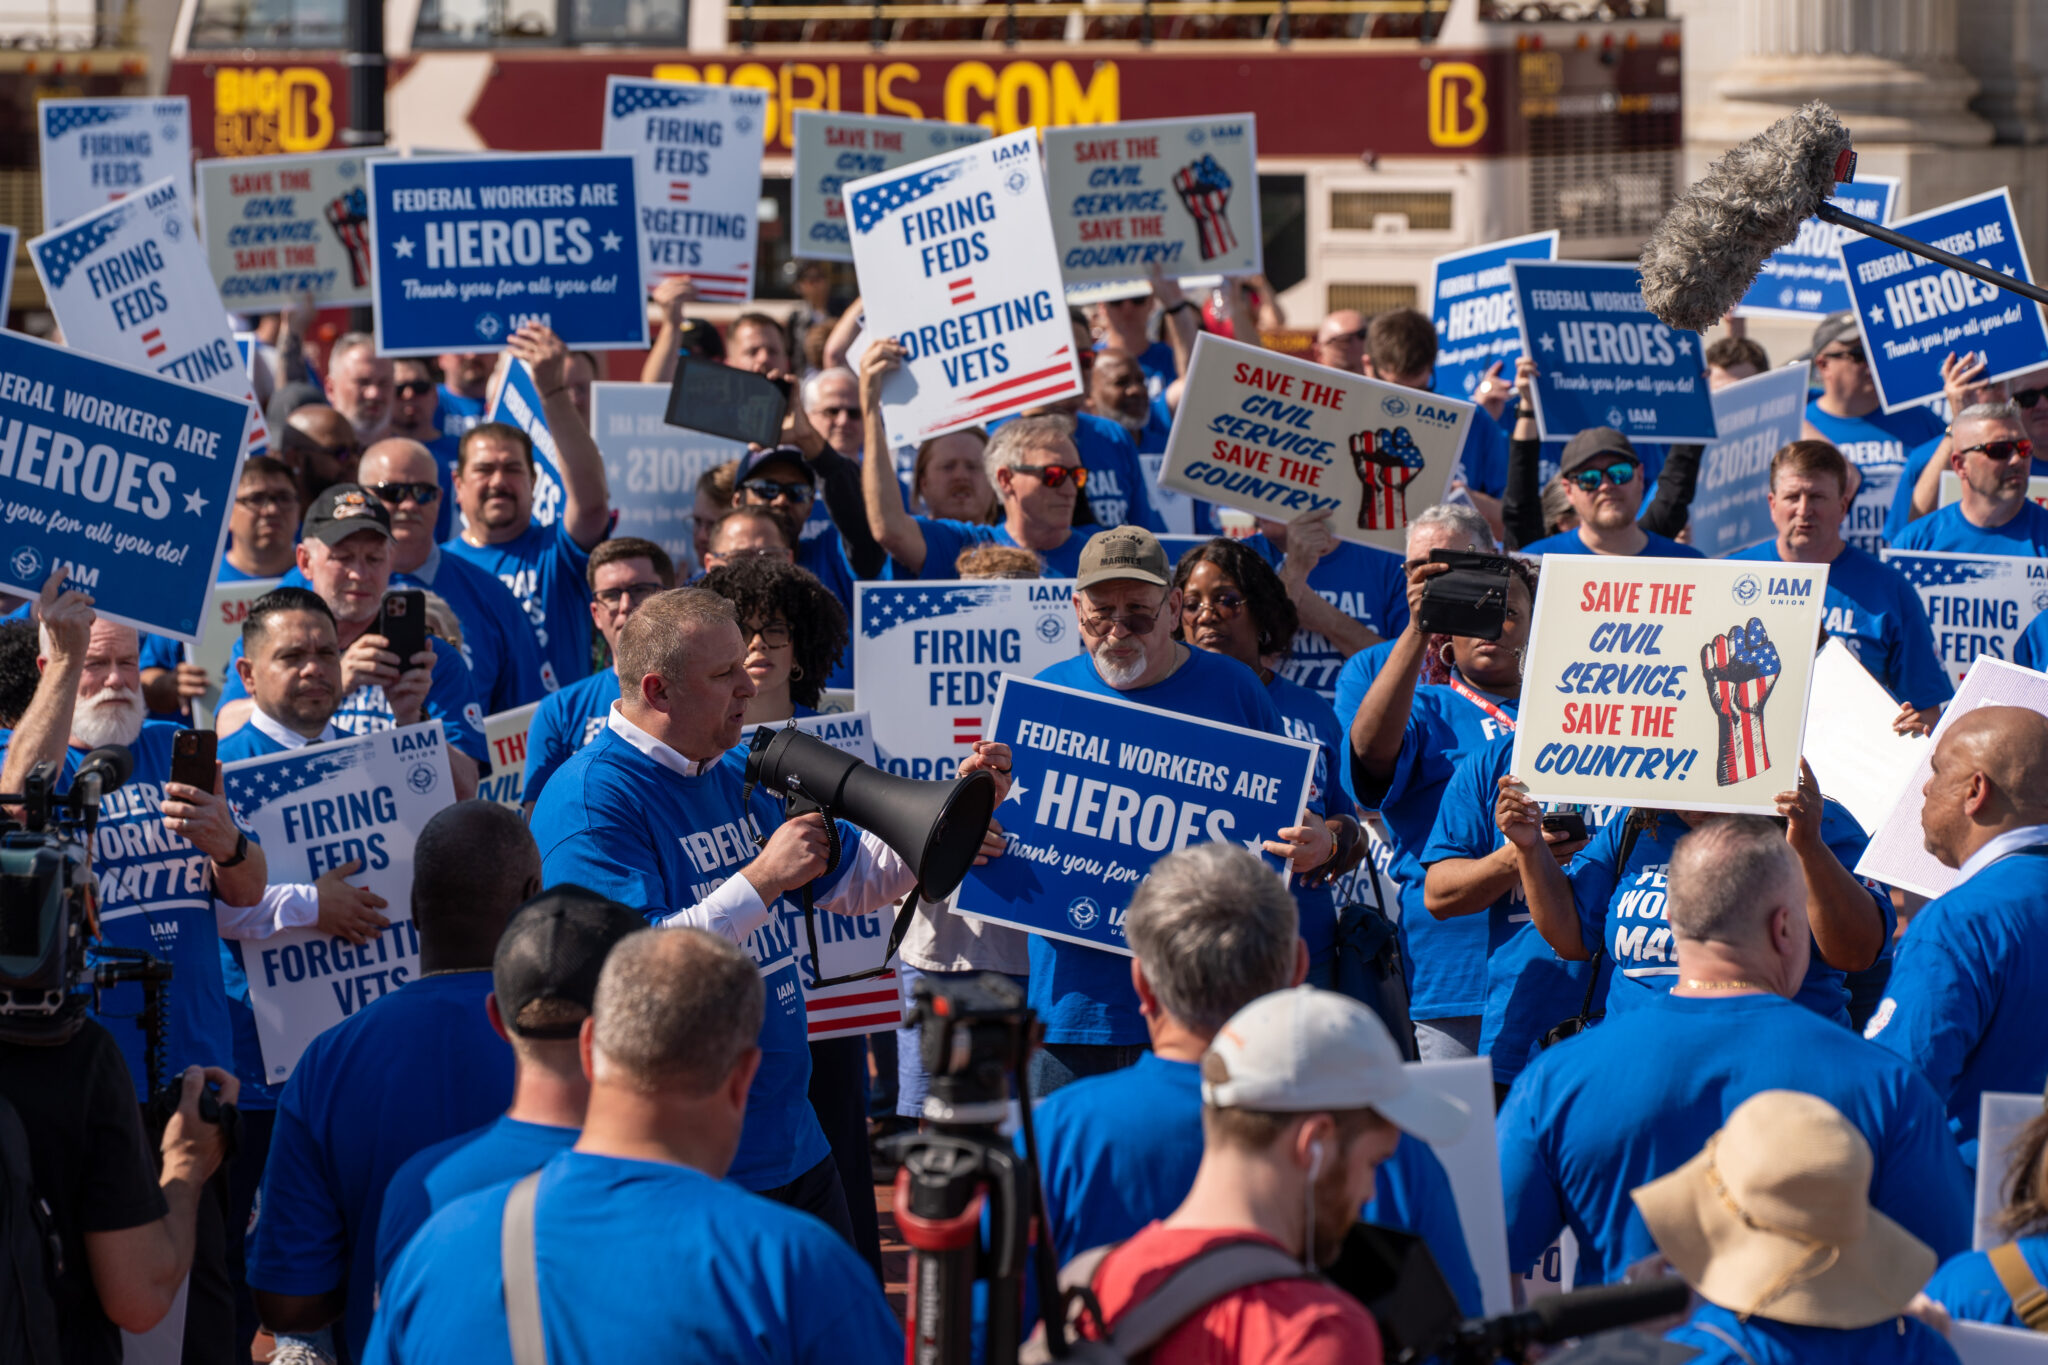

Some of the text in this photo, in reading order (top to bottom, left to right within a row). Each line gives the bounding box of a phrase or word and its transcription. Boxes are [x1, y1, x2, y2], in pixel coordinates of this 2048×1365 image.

[213, 67, 280, 115] BIG
[80, 131, 153, 159] FIRING
[646, 116, 723, 148] FIRING
[825, 126, 904, 152] SAVE THE
[654, 147, 710, 176] FEDS
[835, 152, 886, 172] CIVIL
[992, 140, 1031, 164] IAM
[1074, 136, 1162, 163] SAVE THE
[91, 160, 144, 188] FEDS
[229, 168, 312, 197] SAVE THE
[1088, 165, 1143, 188] CIVIL
[145, 185, 177, 211] IAM
[243, 197, 295, 219] CIVIL
[392, 183, 619, 213] FEDERAL WORKERS ARE
[1072, 189, 1168, 217] SERVICE,
[226, 219, 321, 248] SERVICE,
[641, 207, 747, 241] RGETTING
[901, 191, 996, 246] FIRING
[1079, 214, 1164, 242] SAVE THE
[234, 243, 317, 273] SAVE THE
[424, 217, 594, 269] HEROES
[649, 239, 704, 268] VETS
[921, 231, 989, 278] FEDS
[1064, 241, 1184, 269] COUNTRY!
[1856, 251, 1914, 285] FEDERAL
[1975, 221, 2006, 249] ARE
[85, 238, 166, 301] FIRING
[221, 270, 338, 298] COUNTRY!
[401, 274, 619, 302] Thank you for all you do!
[1531, 290, 1648, 313] FEDERAL WORKE
[1884, 258, 2000, 329] HEROES
[110, 281, 168, 332] FEDS
[1447, 290, 1520, 342] HEROE
[1558, 321, 1675, 366] HEROES
[1883, 302, 2023, 360] Thank you for all you do!
[942, 342, 1010, 388] VETS
[1233, 362, 1347, 411] SAVE THE
[1550, 371, 1591, 390] Thank
[1590, 377, 1614, 396] you
[1613, 375, 1635, 395] for
[1635, 375, 1651, 392] all
[1650, 377, 1676, 397] you
[0, 371, 221, 460] ERAL WORKERS ARE
[1241, 394, 1315, 430] CIVIL
[1414, 403, 1458, 425] IAM
[1627, 408, 1657, 424] IAM
[1207, 414, 1336, 465] SERVICE,
[1839, 441, 1907, 463] DERAL
[0, 415, 177, 521] HEROES
[1212, 440, 1325, 487] SAVE THE
[1183, 461, 1342, 512] COUNTRY!
[4, 501, 190, 566] you for all you do!
[50, 556, 100, 588] IAM
[1100, 556, 1142, 567] MARINES
[2027, 565, 2048, 579] IA
[1028, 585, 1072, 602] IAM
[1580, 581, 1696, 615] SAVE THE
[1767, 577, 1812, 597] IAM
[1928, 595, 2019, 630] FIRING
[914, 629, 1021, 665] FIRING
[1589, 622, 1664, 656] CIVIL
[1940, 633, 2005, 663] FEDS
[929, 671, 998, 706] FEDS
[1555, 661, 1688, 701] SERVICE,
[816, 719, 864, 741] IAM
[1562, 702, 1677, 738] SAVE THE
[391, 729, 438, 755] IAM
[399, 750, 437, 762] UNION
[831, 740, 861, 748] NION
[1016, 718, 1282, 805] FEDERAL WORKERS ARE
[1534, 742, 1698, 781] COUNTRY!
[477, 772, 522, 802] IVIL
[281, 785, 398, 844] FIRING
[1035, 769, 1236, 855] HEROES
[73, 818, 193, 863] WORKE
[306, 833, 391, 881] FEDS
[1001, 831, 1140, 885] Thank you for
[150, 921, 179, 936] IAM
[1108, 906, 1127, 926] IA
[261, 918, 420, 987] FORGETTI
[776, 980, 796, 1001] IAM
